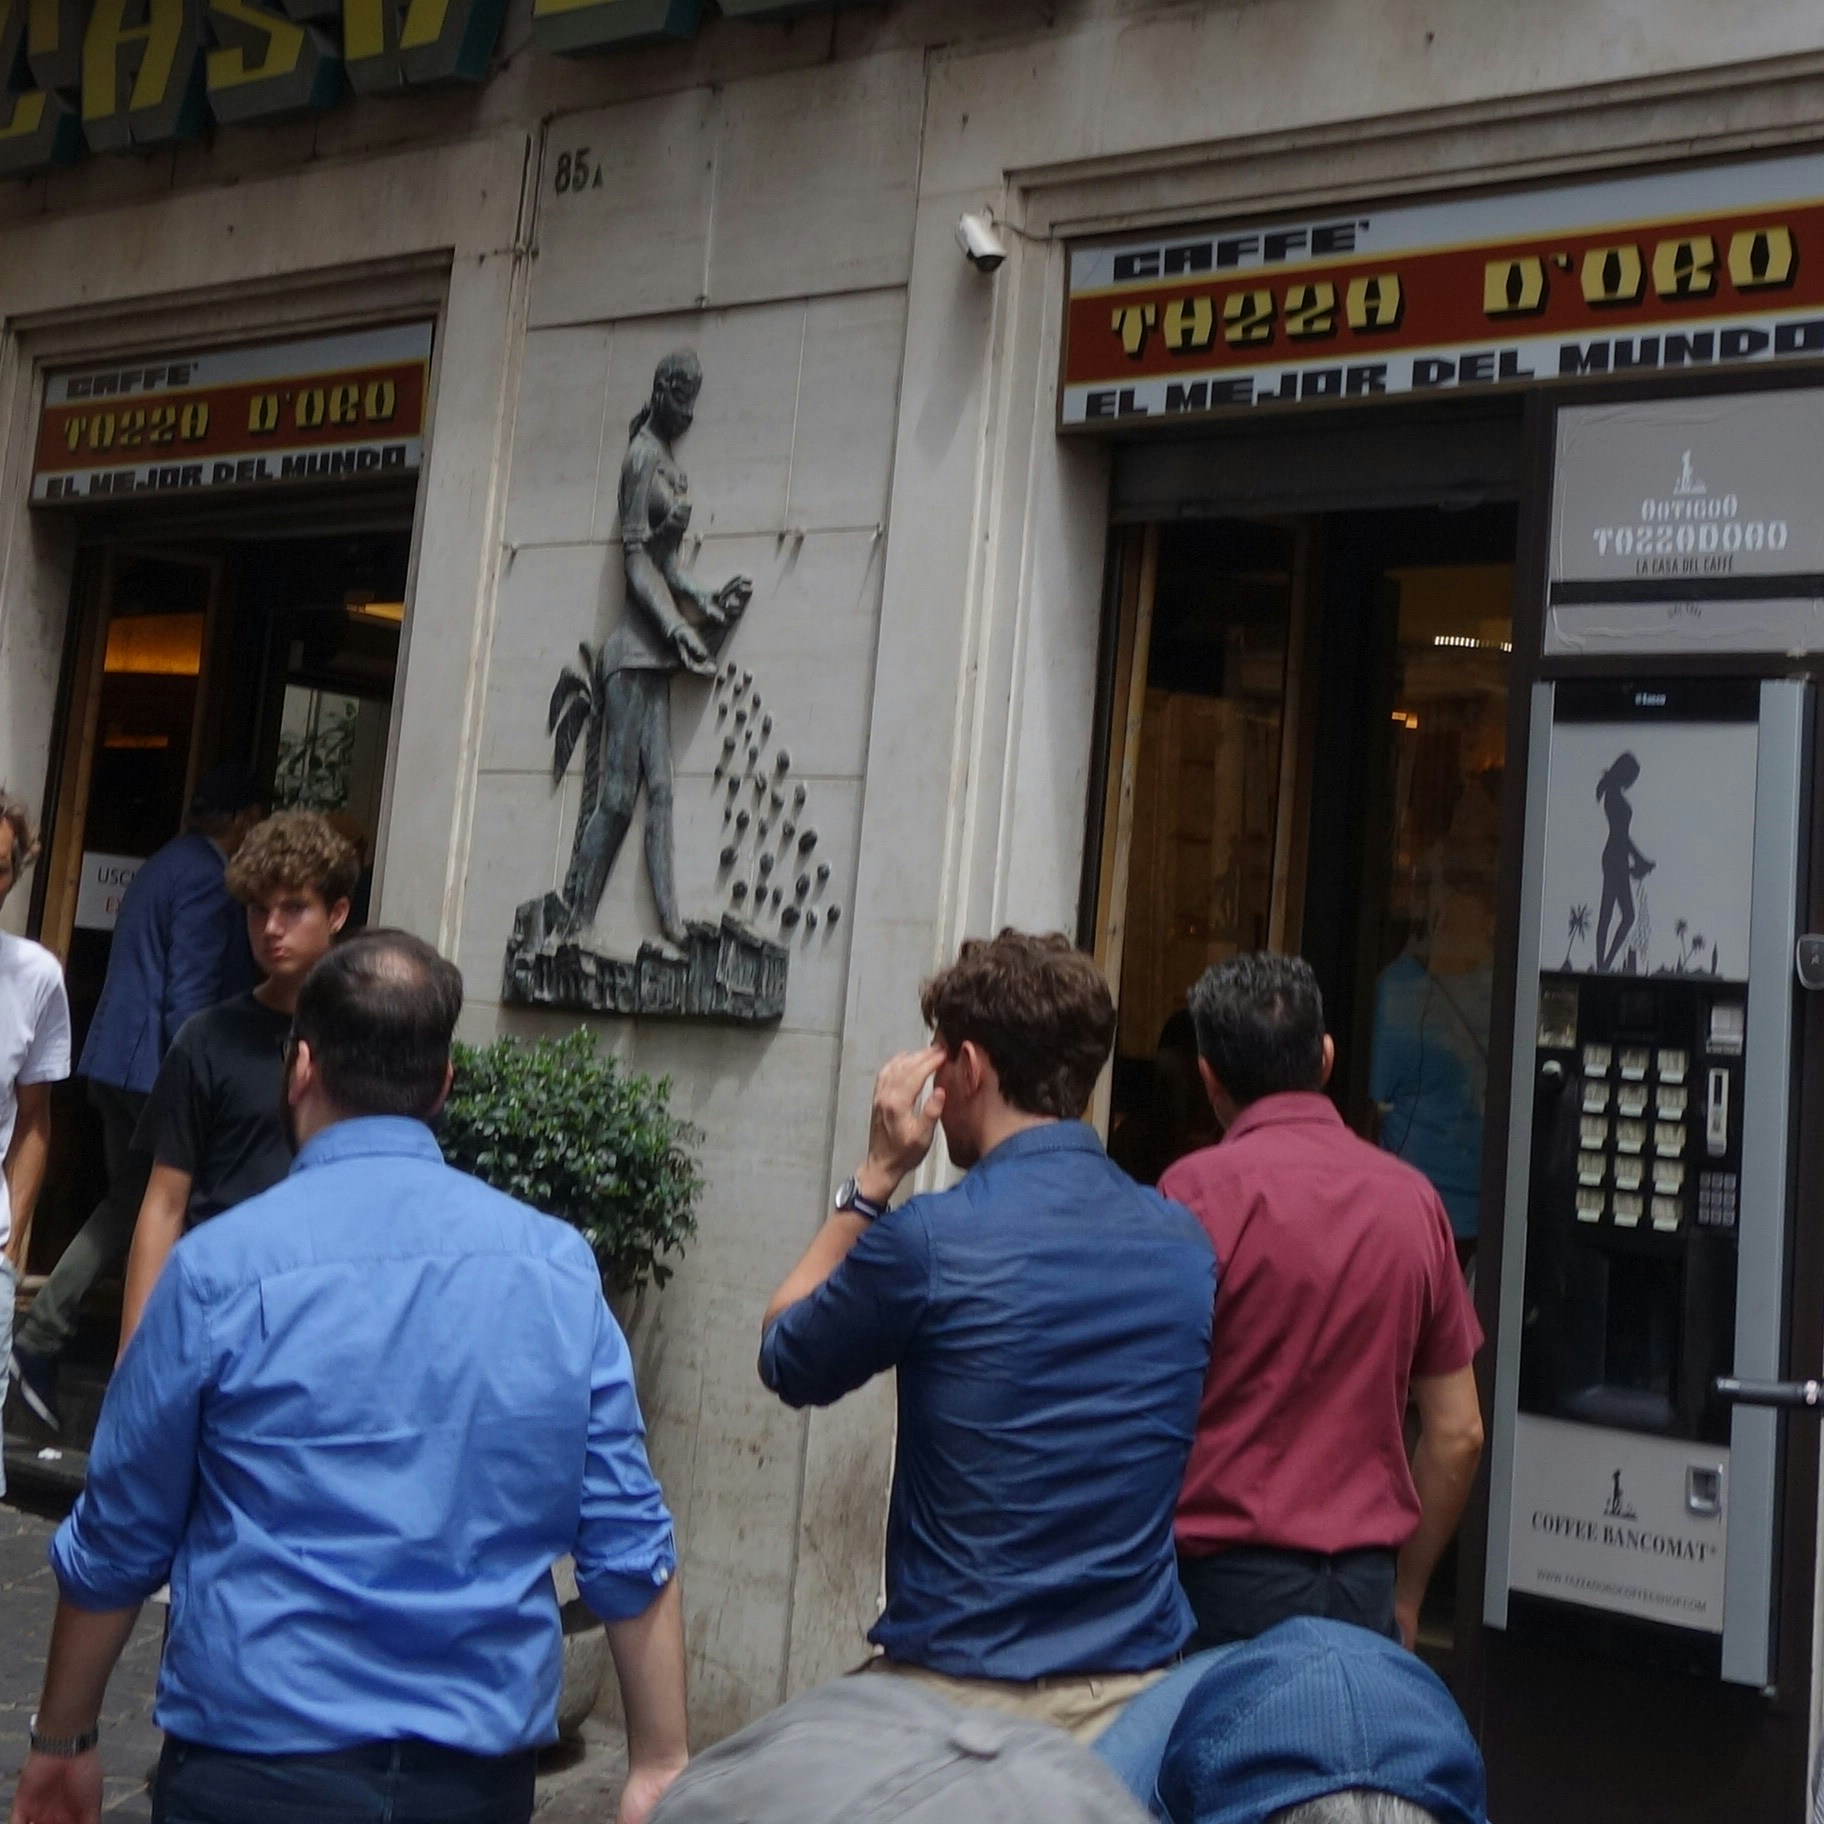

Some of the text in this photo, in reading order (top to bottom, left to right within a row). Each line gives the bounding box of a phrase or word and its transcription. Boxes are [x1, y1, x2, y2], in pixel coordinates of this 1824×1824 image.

[1110, 223, 1794, 358] TAZZA D'ORO
[64, 378, 397, 452] TAZZA D'ORO
[1085, 386, 1148, 422] EL
[1165, 361, 1388, 413] MEJOR
[1410, 348, 1537, 388] DEL
[45, 445, 408, 500] EL MEJOR DEL MUNDO
[1636, 558, 1648, 575] LA
[1652, 557, 1678, 575] CASA
[1682, 556, 1700, 574] DEL
[1532, 1510, 1598, 1543] COFFEE
